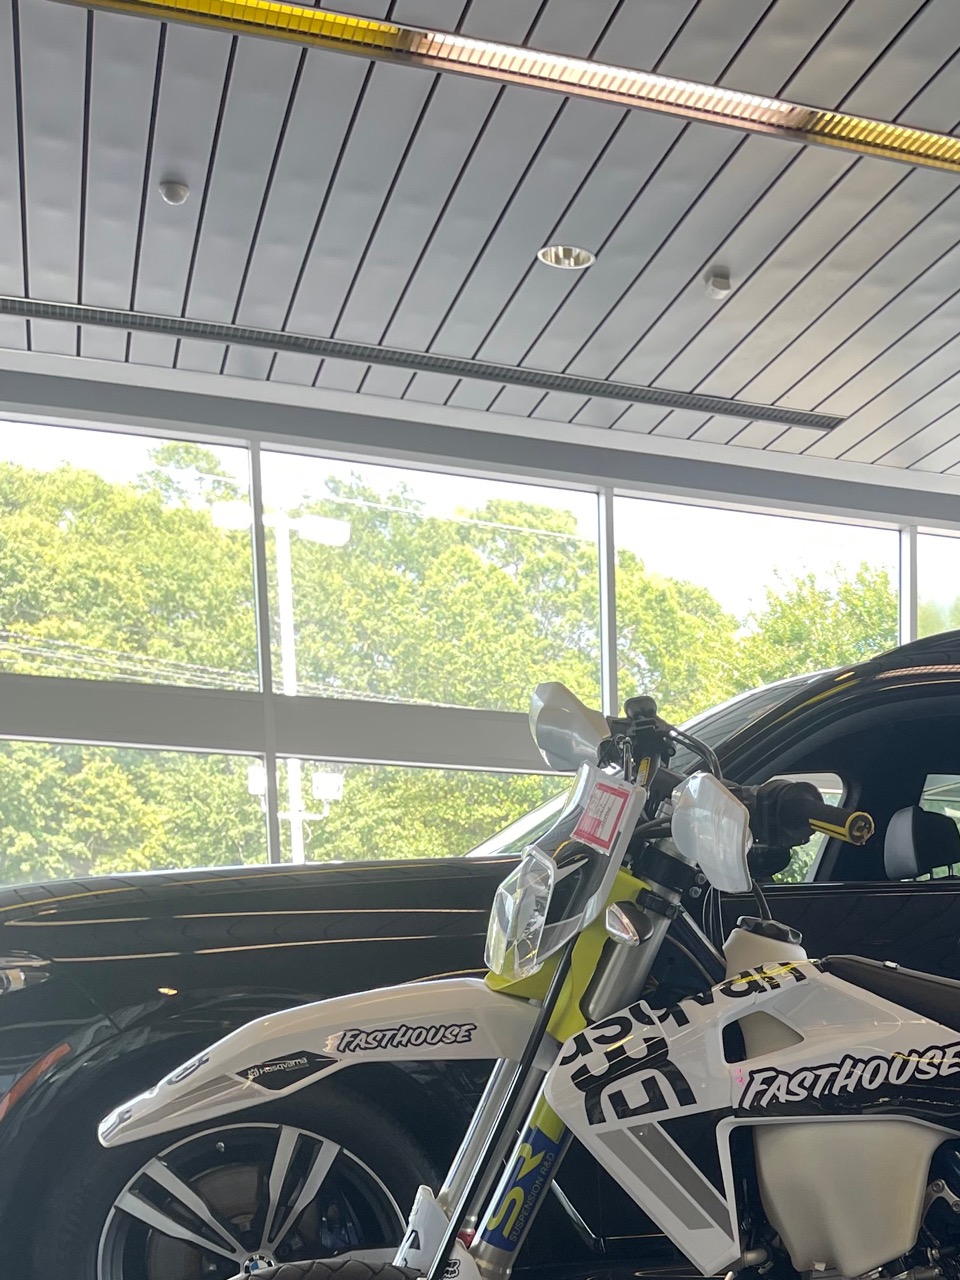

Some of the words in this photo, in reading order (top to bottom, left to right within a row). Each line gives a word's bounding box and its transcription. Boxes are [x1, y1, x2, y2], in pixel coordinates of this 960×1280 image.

[337, 1023, 477, 1053] FASTHOUSE
[259, 1056, 308, 1075] Husqvarna
[509, 1175, 545, 1242] SUSPENSION
[540, 1152, 555, 1177] R&D
